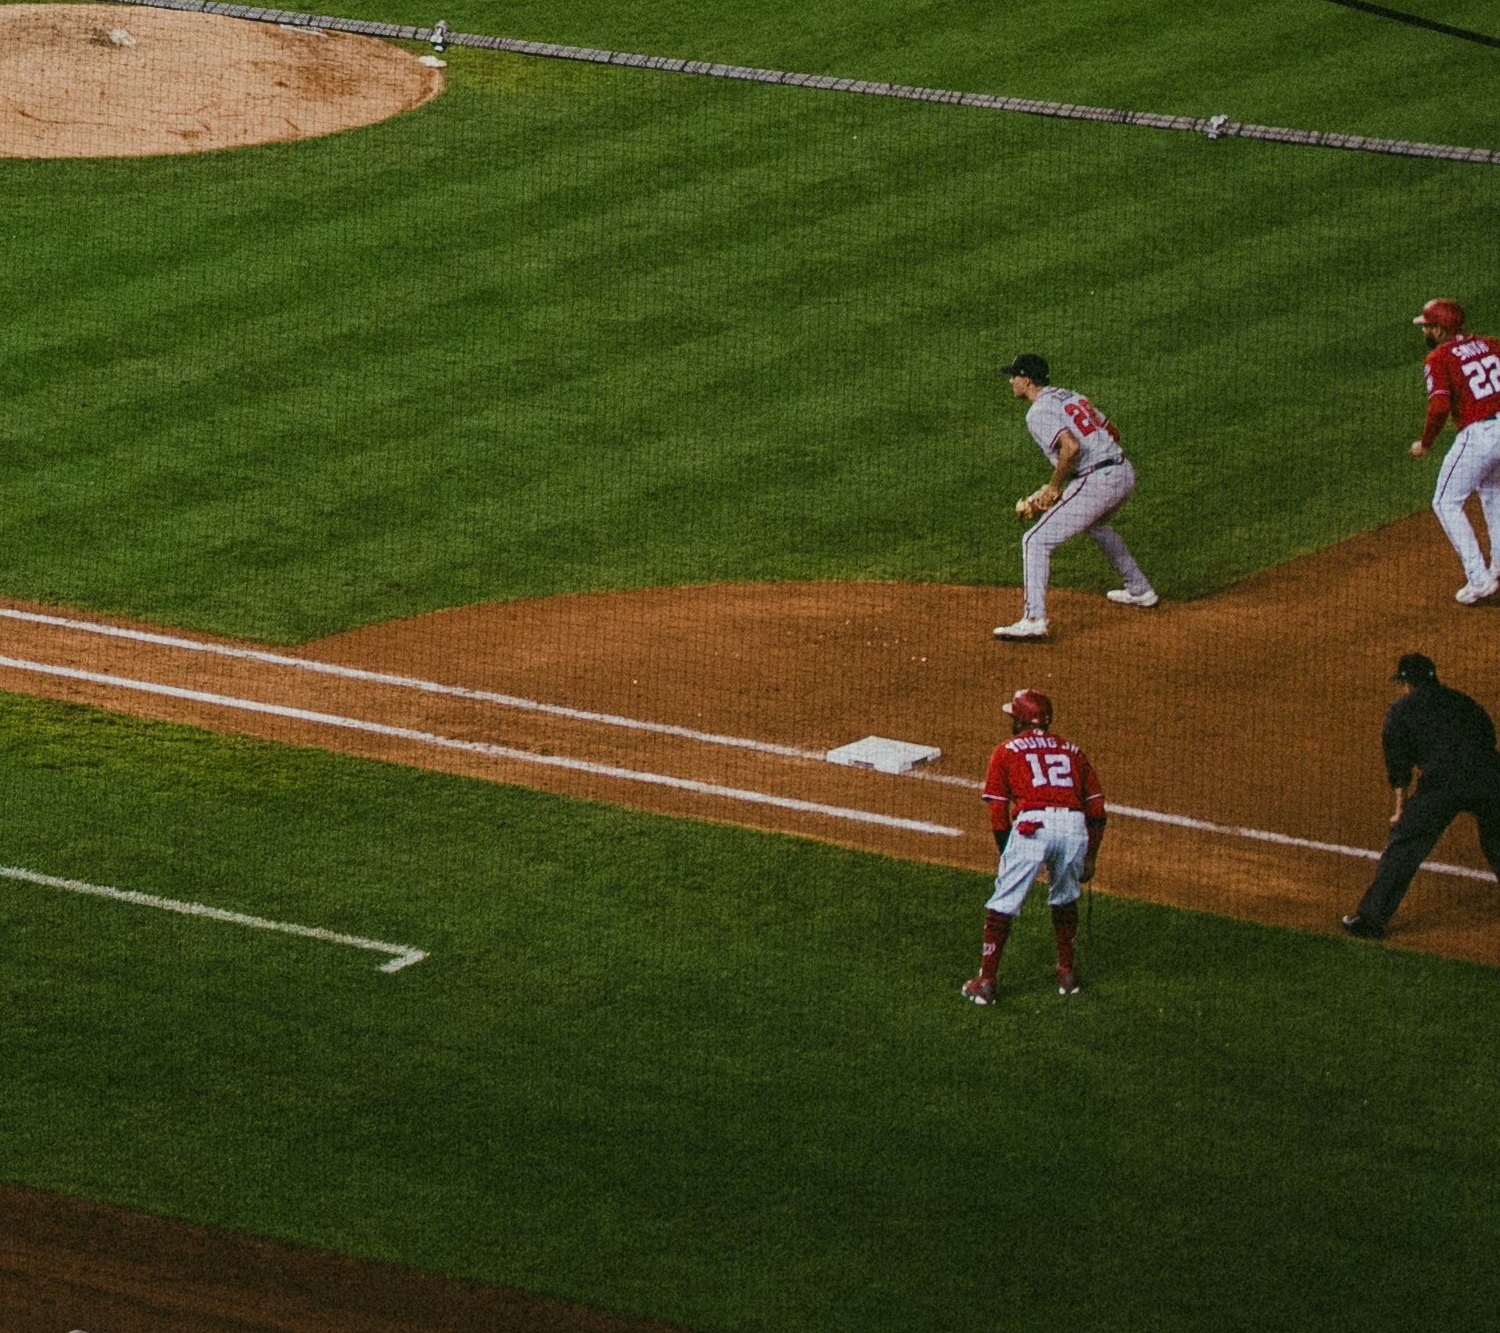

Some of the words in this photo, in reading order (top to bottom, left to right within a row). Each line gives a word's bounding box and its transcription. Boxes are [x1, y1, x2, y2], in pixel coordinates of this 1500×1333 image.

[1462, 355, 1500, 402] 22
[1004, 736, 1058, 754] YOUNG
[1026, 754, 1074, 789] 12
